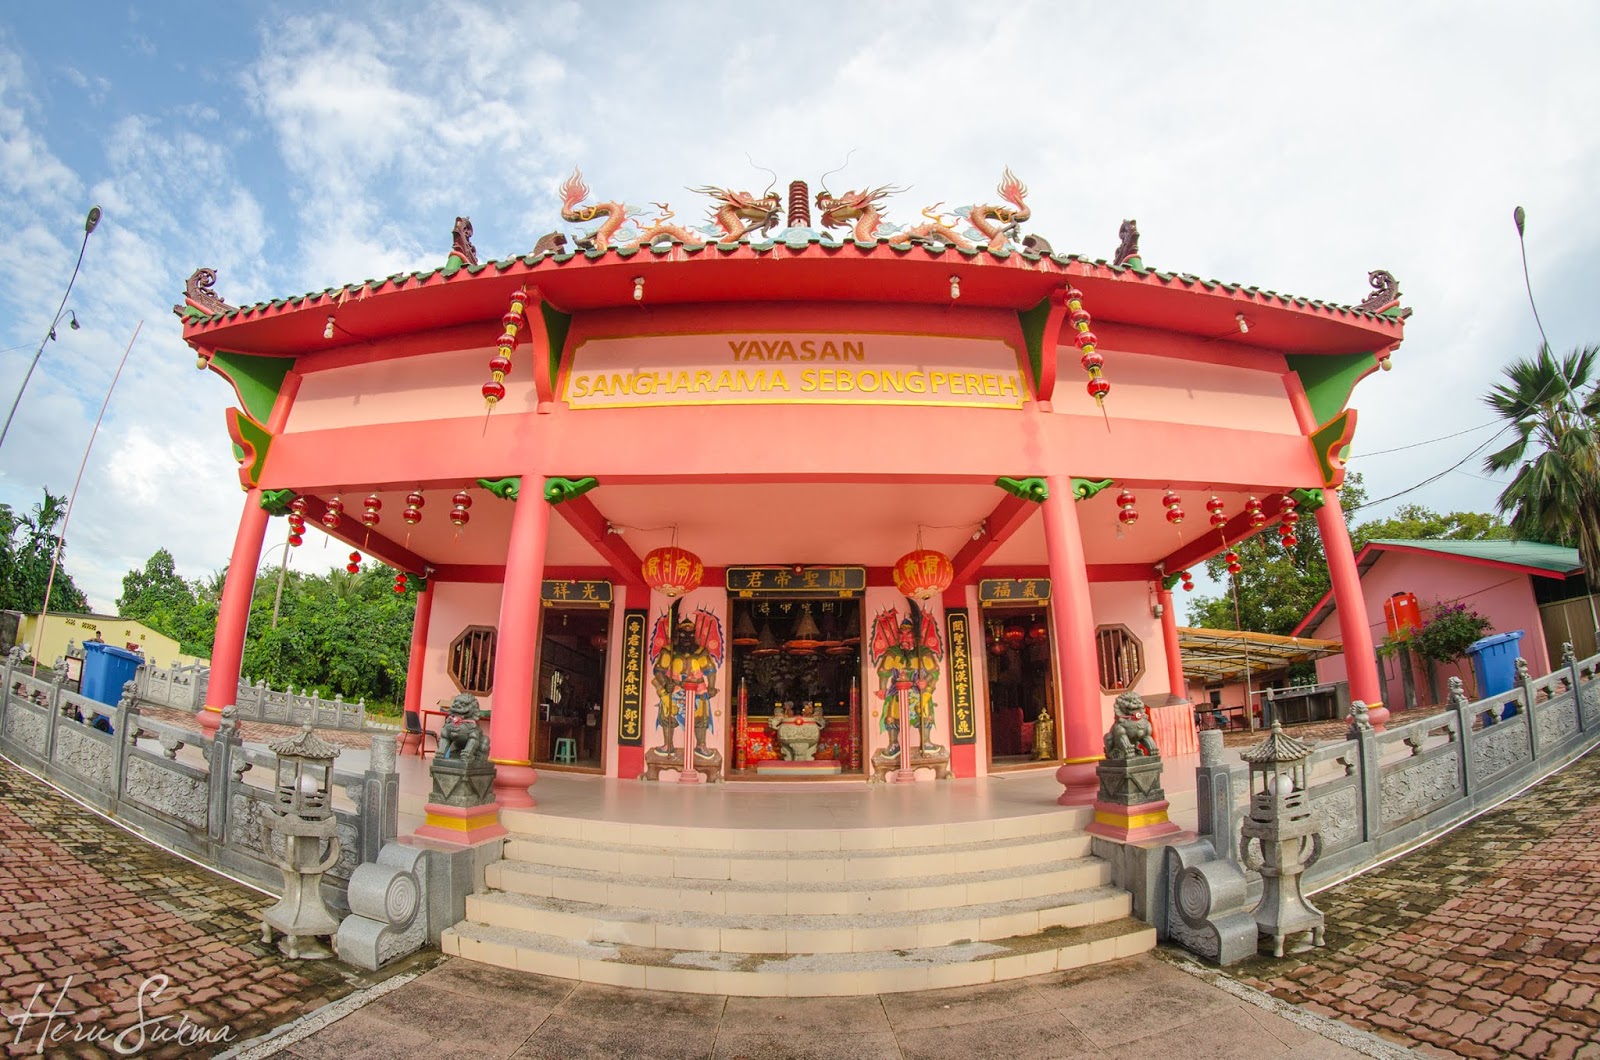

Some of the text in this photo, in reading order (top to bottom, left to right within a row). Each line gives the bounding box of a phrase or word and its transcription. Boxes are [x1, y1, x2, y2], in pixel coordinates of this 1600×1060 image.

[728, 340, 865, 363] YAYASAN
[571, 368, 1019, 398] SANGHARAMA SEBONG PEREH
